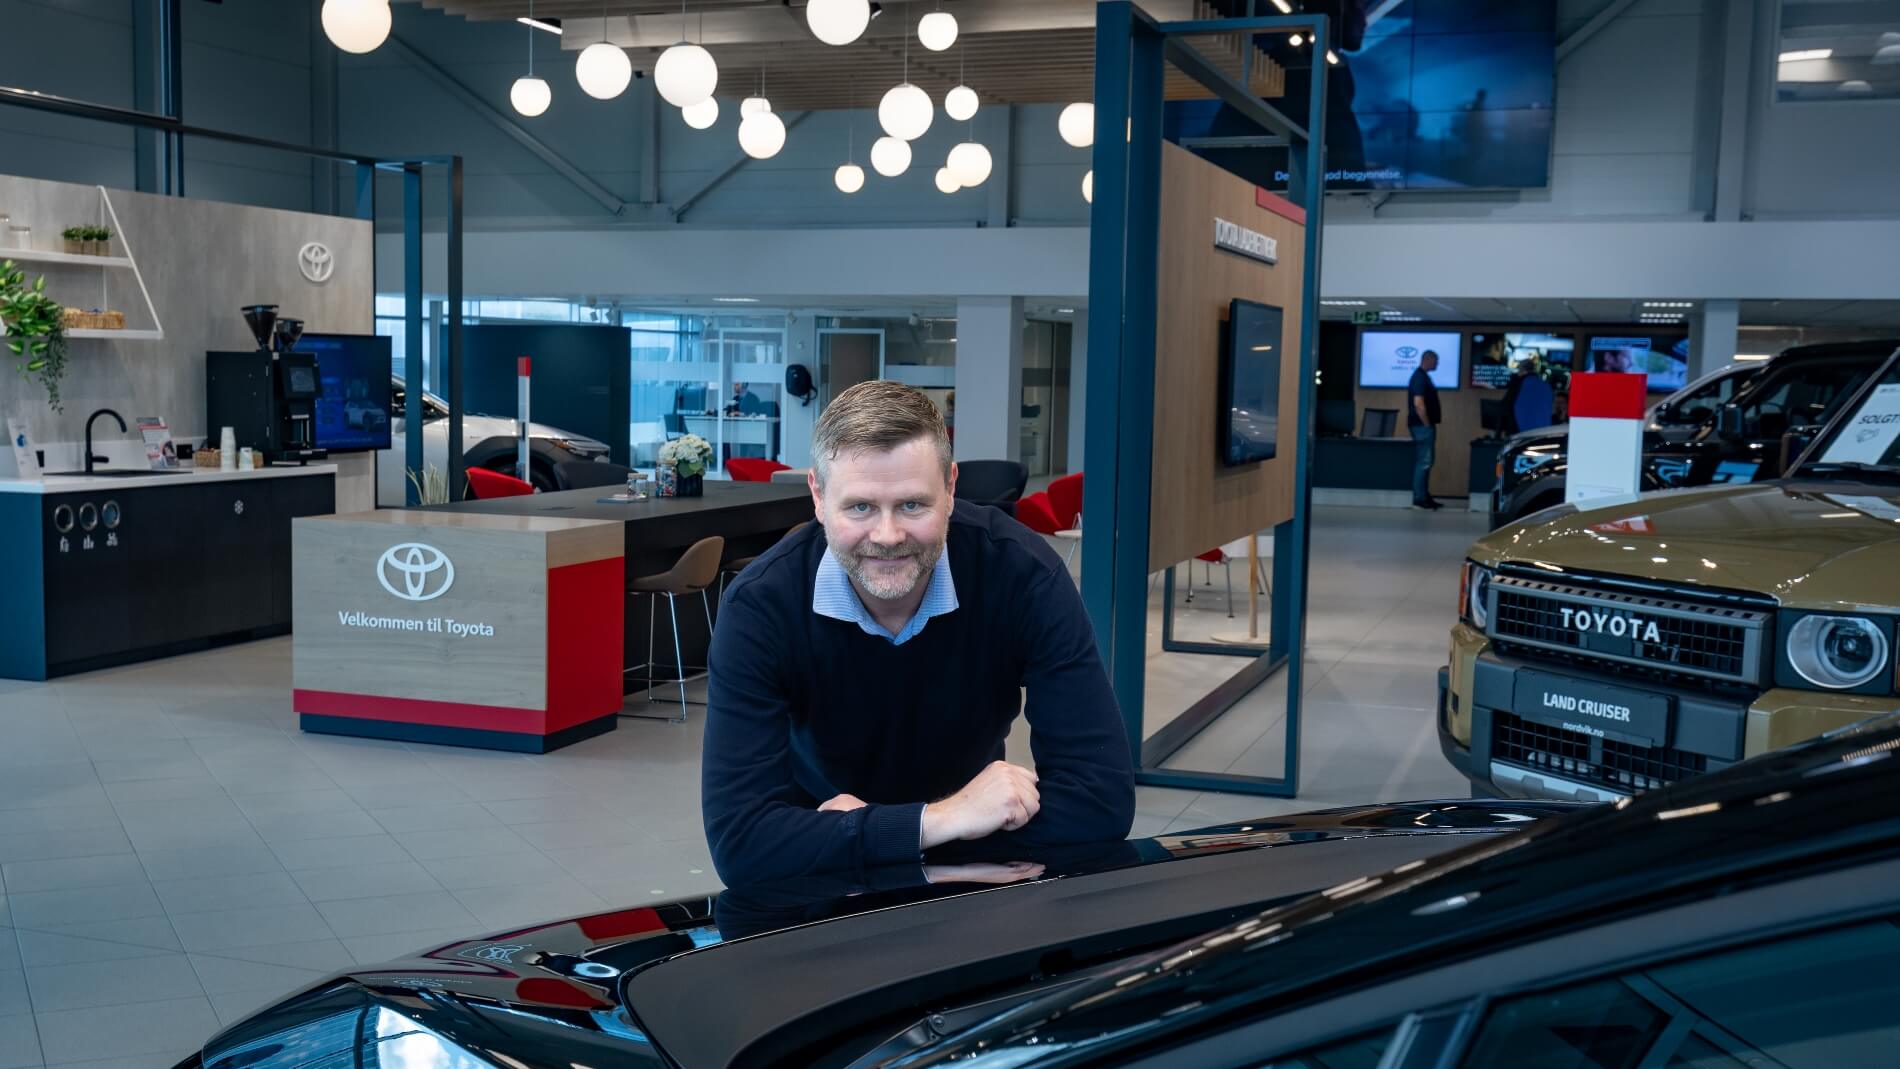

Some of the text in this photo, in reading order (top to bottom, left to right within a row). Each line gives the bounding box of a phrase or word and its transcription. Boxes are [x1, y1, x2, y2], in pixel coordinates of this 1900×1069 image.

[338, 611, 494, 637] Velkommen til Toyota
[1560, 607, 1660, 642] TOYOTA
[1543, 692, 1630, 722] LAND CRUISER
[1562, 722, 1604, 737] nordvik.no
